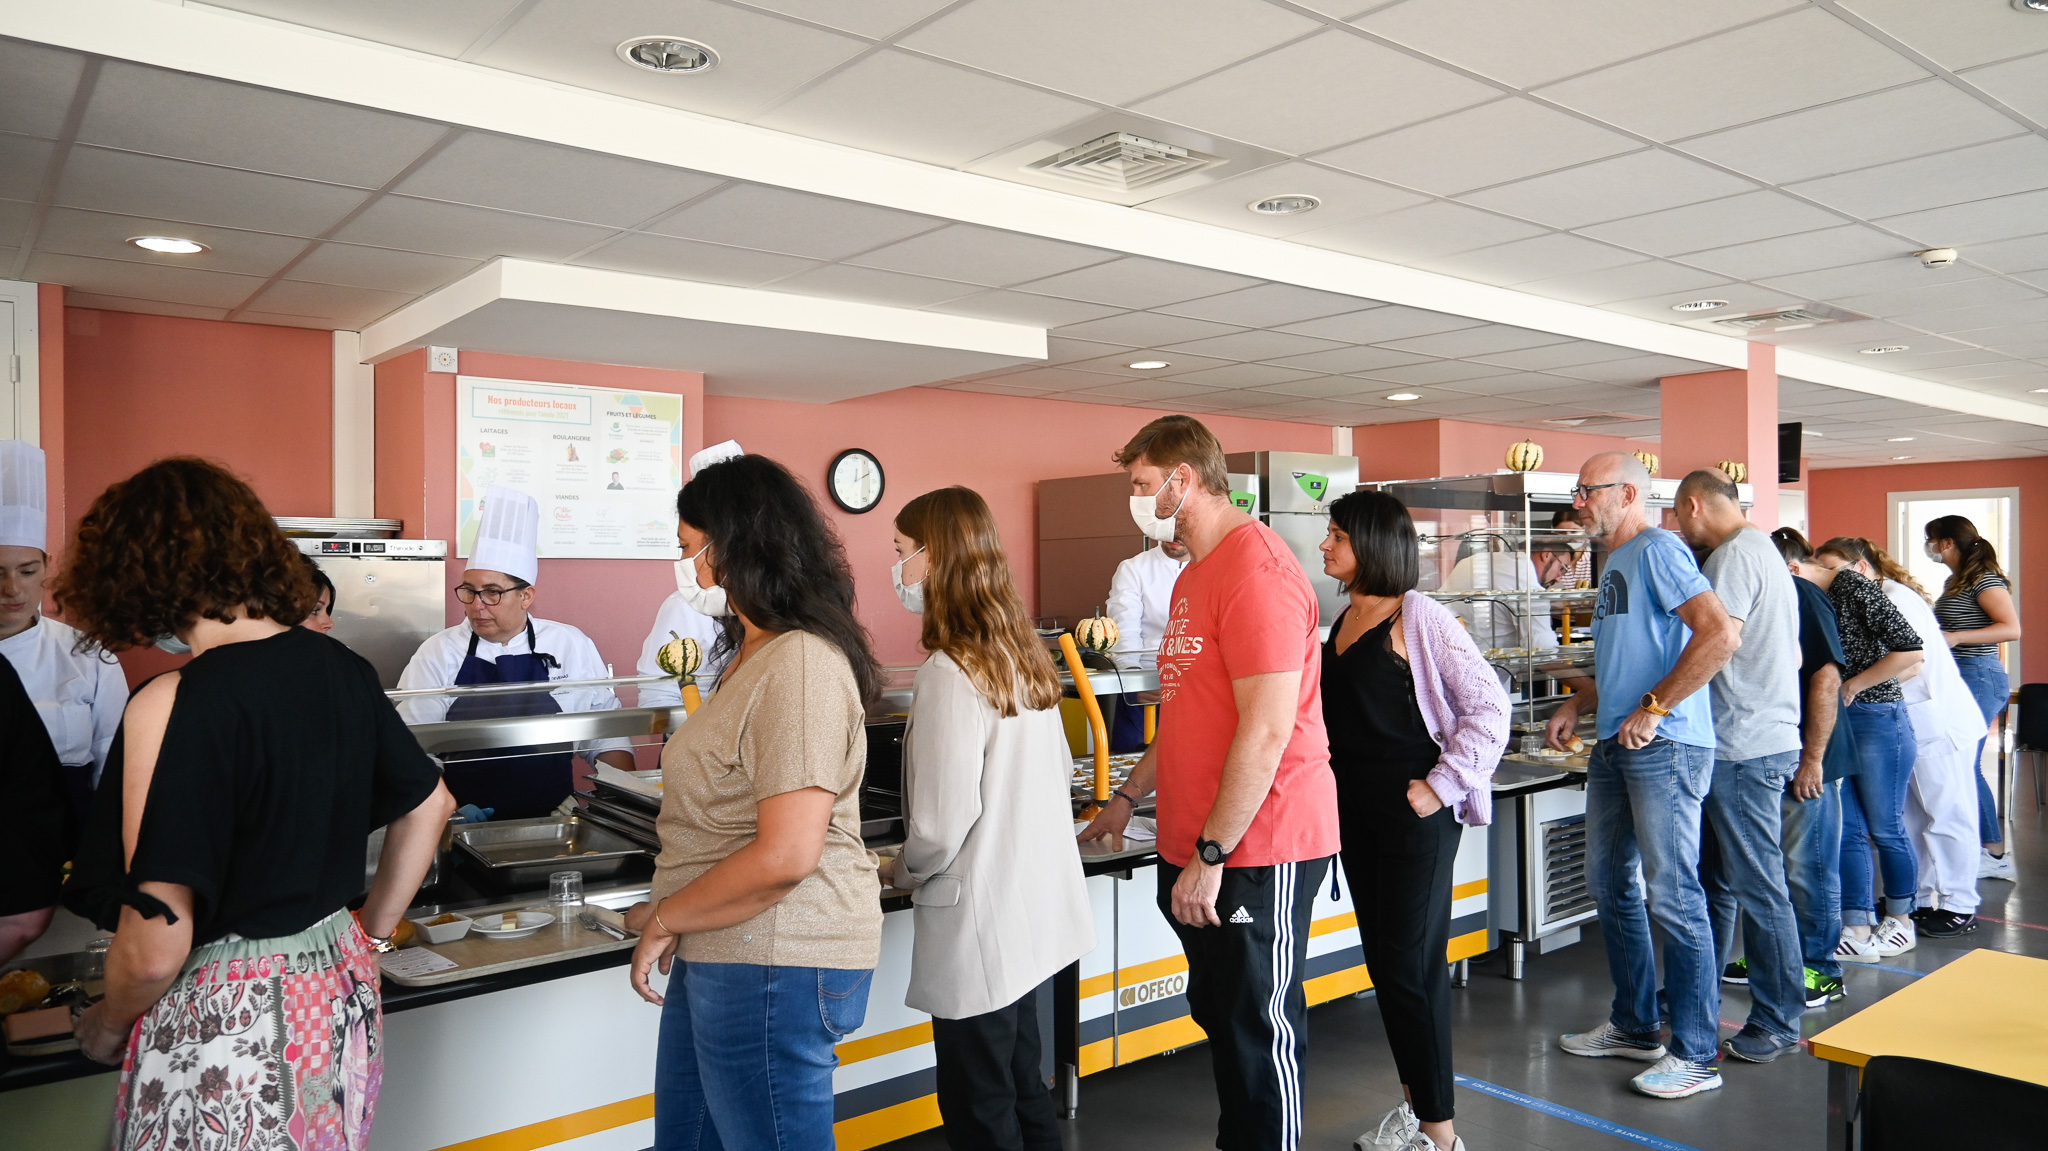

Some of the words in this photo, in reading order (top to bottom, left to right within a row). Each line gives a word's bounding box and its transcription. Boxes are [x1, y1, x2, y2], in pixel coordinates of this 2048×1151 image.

[488, 395, 502, 405] Nos
[504, 397, 551, 408] producteurs
[553, 400, 577, 410] locaux
[606, 410, 625, 418] FRUITS
[480, 427, 509, 435] LAITAGES
[552, 434, 592, 442] BOULANGERIE
[1138, 975, 1184, 1003] OFECO
[1484, 1086, 1532, 1104] PATIENTER
[1614, 1128, 1649, 1141] SANTÉ
